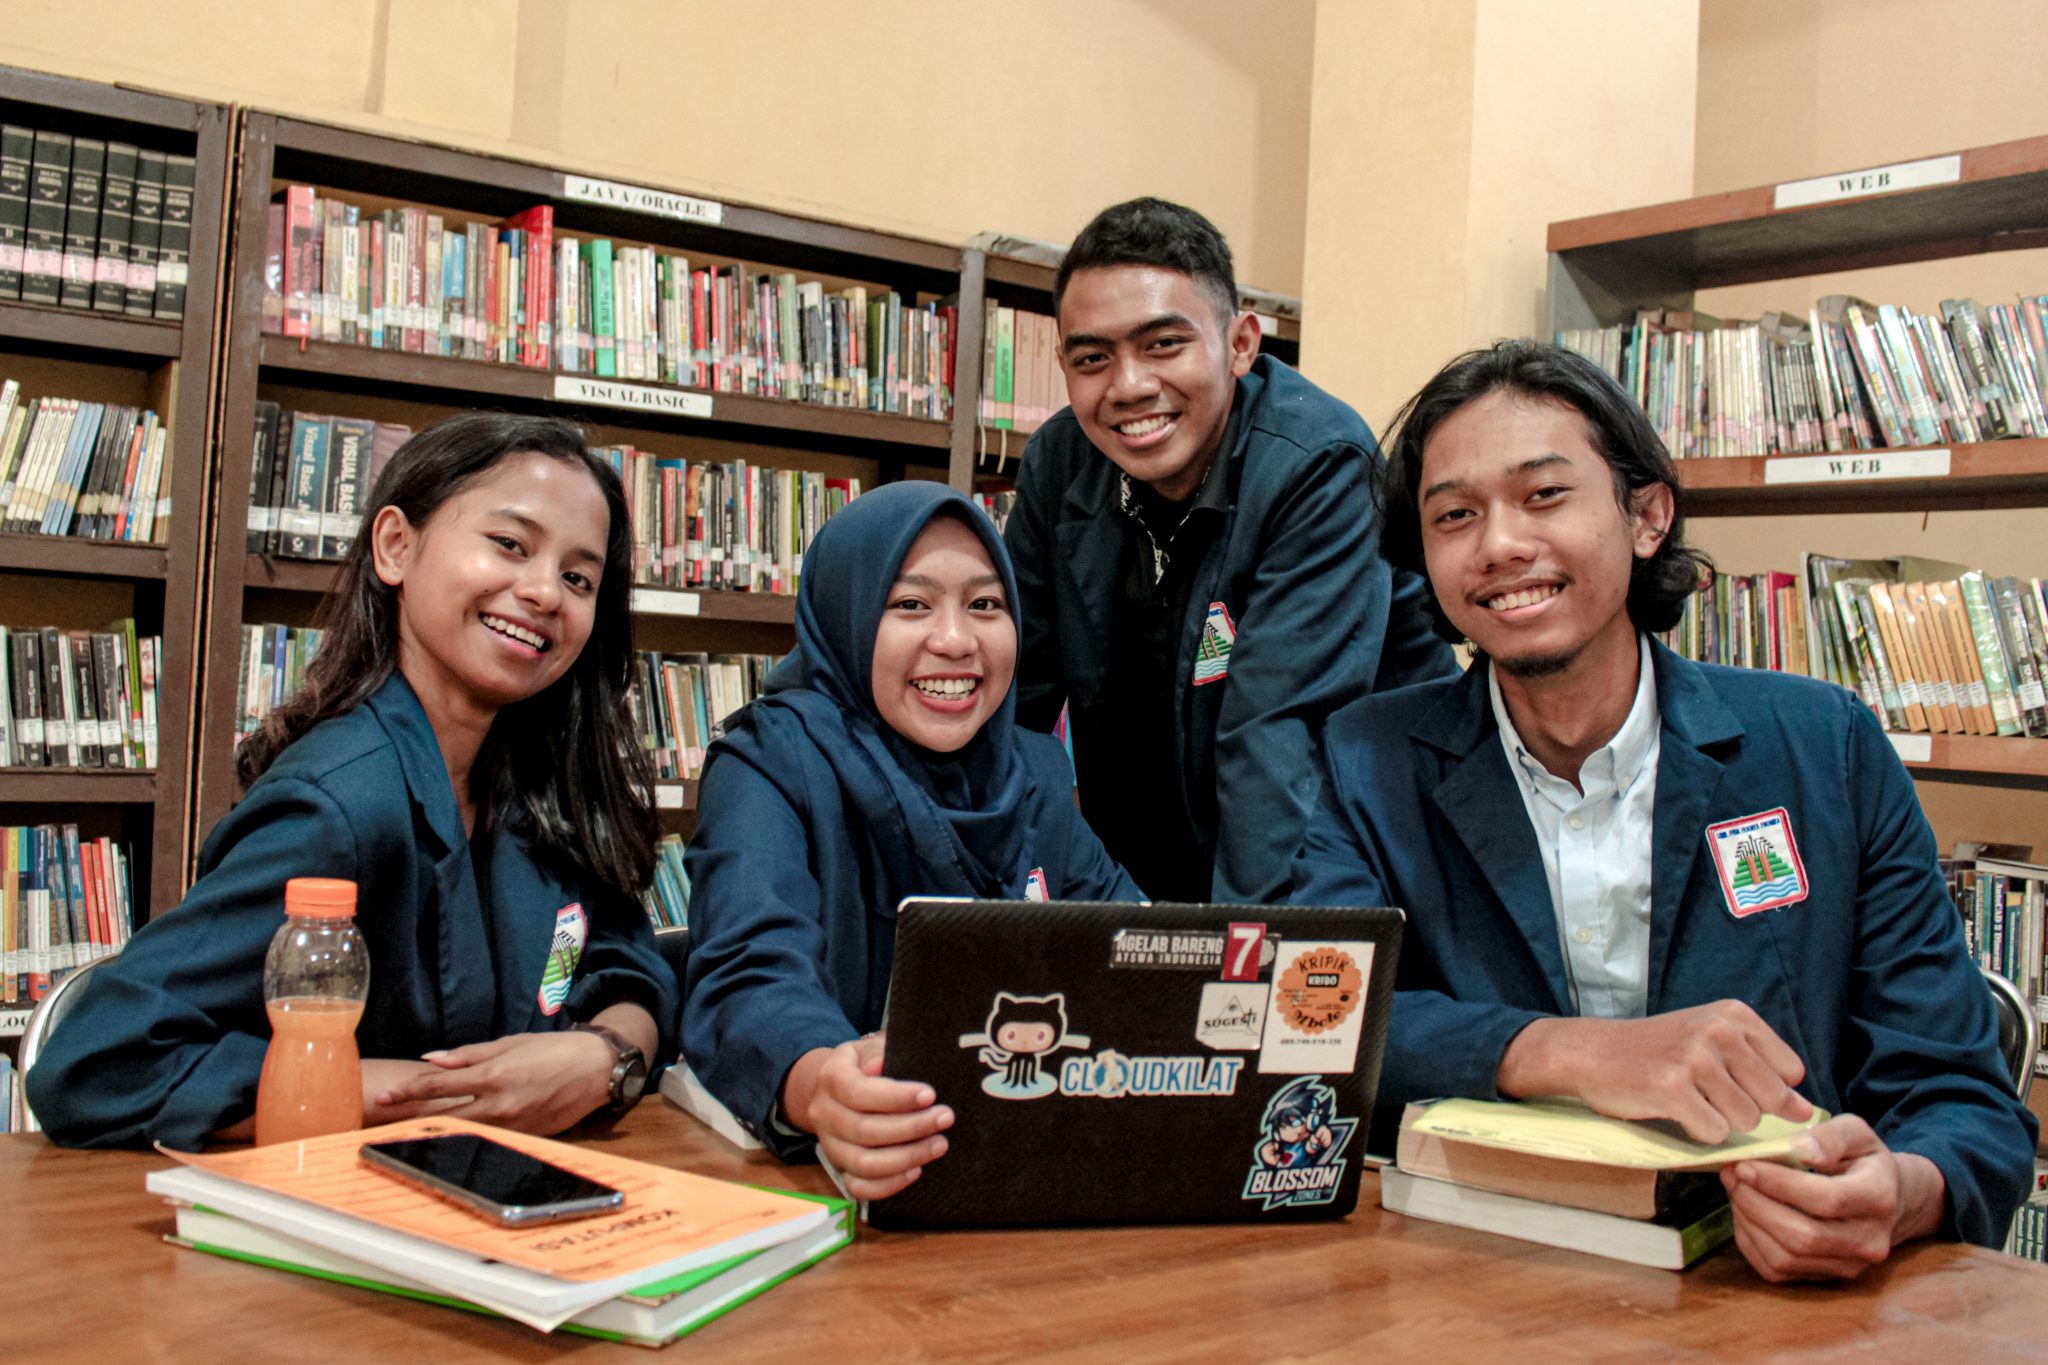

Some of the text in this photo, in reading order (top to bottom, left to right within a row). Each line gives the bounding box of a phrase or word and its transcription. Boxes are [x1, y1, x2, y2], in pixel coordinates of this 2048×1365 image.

[1839, 172, 1891, 193] WEB
[581, 183, 706, 217] JAVA/ORACLE
[580, 384, 689, 409] VISUAL BASIC
[303, 426, 319, 463] Visual
[341, 436, 359, 481] VISUAL
[299, 463, 315, 497] Basic
[1829, 458, 1882, 475] WEB
[1116, 934, 1224, 954] NGELAB BARENG
[1232, 927, 1261, 977] 7
[1965, 919, 1974, 959] AutoCA
[1159, 953, 1222, 965] INDONESIA
[1299, 955, 1349, 973] KRIPIK
[1064, 1058, 1240, 1093] CLOUDKILAT
[1250, 1166, 1339, 1193] BLOSSOM
